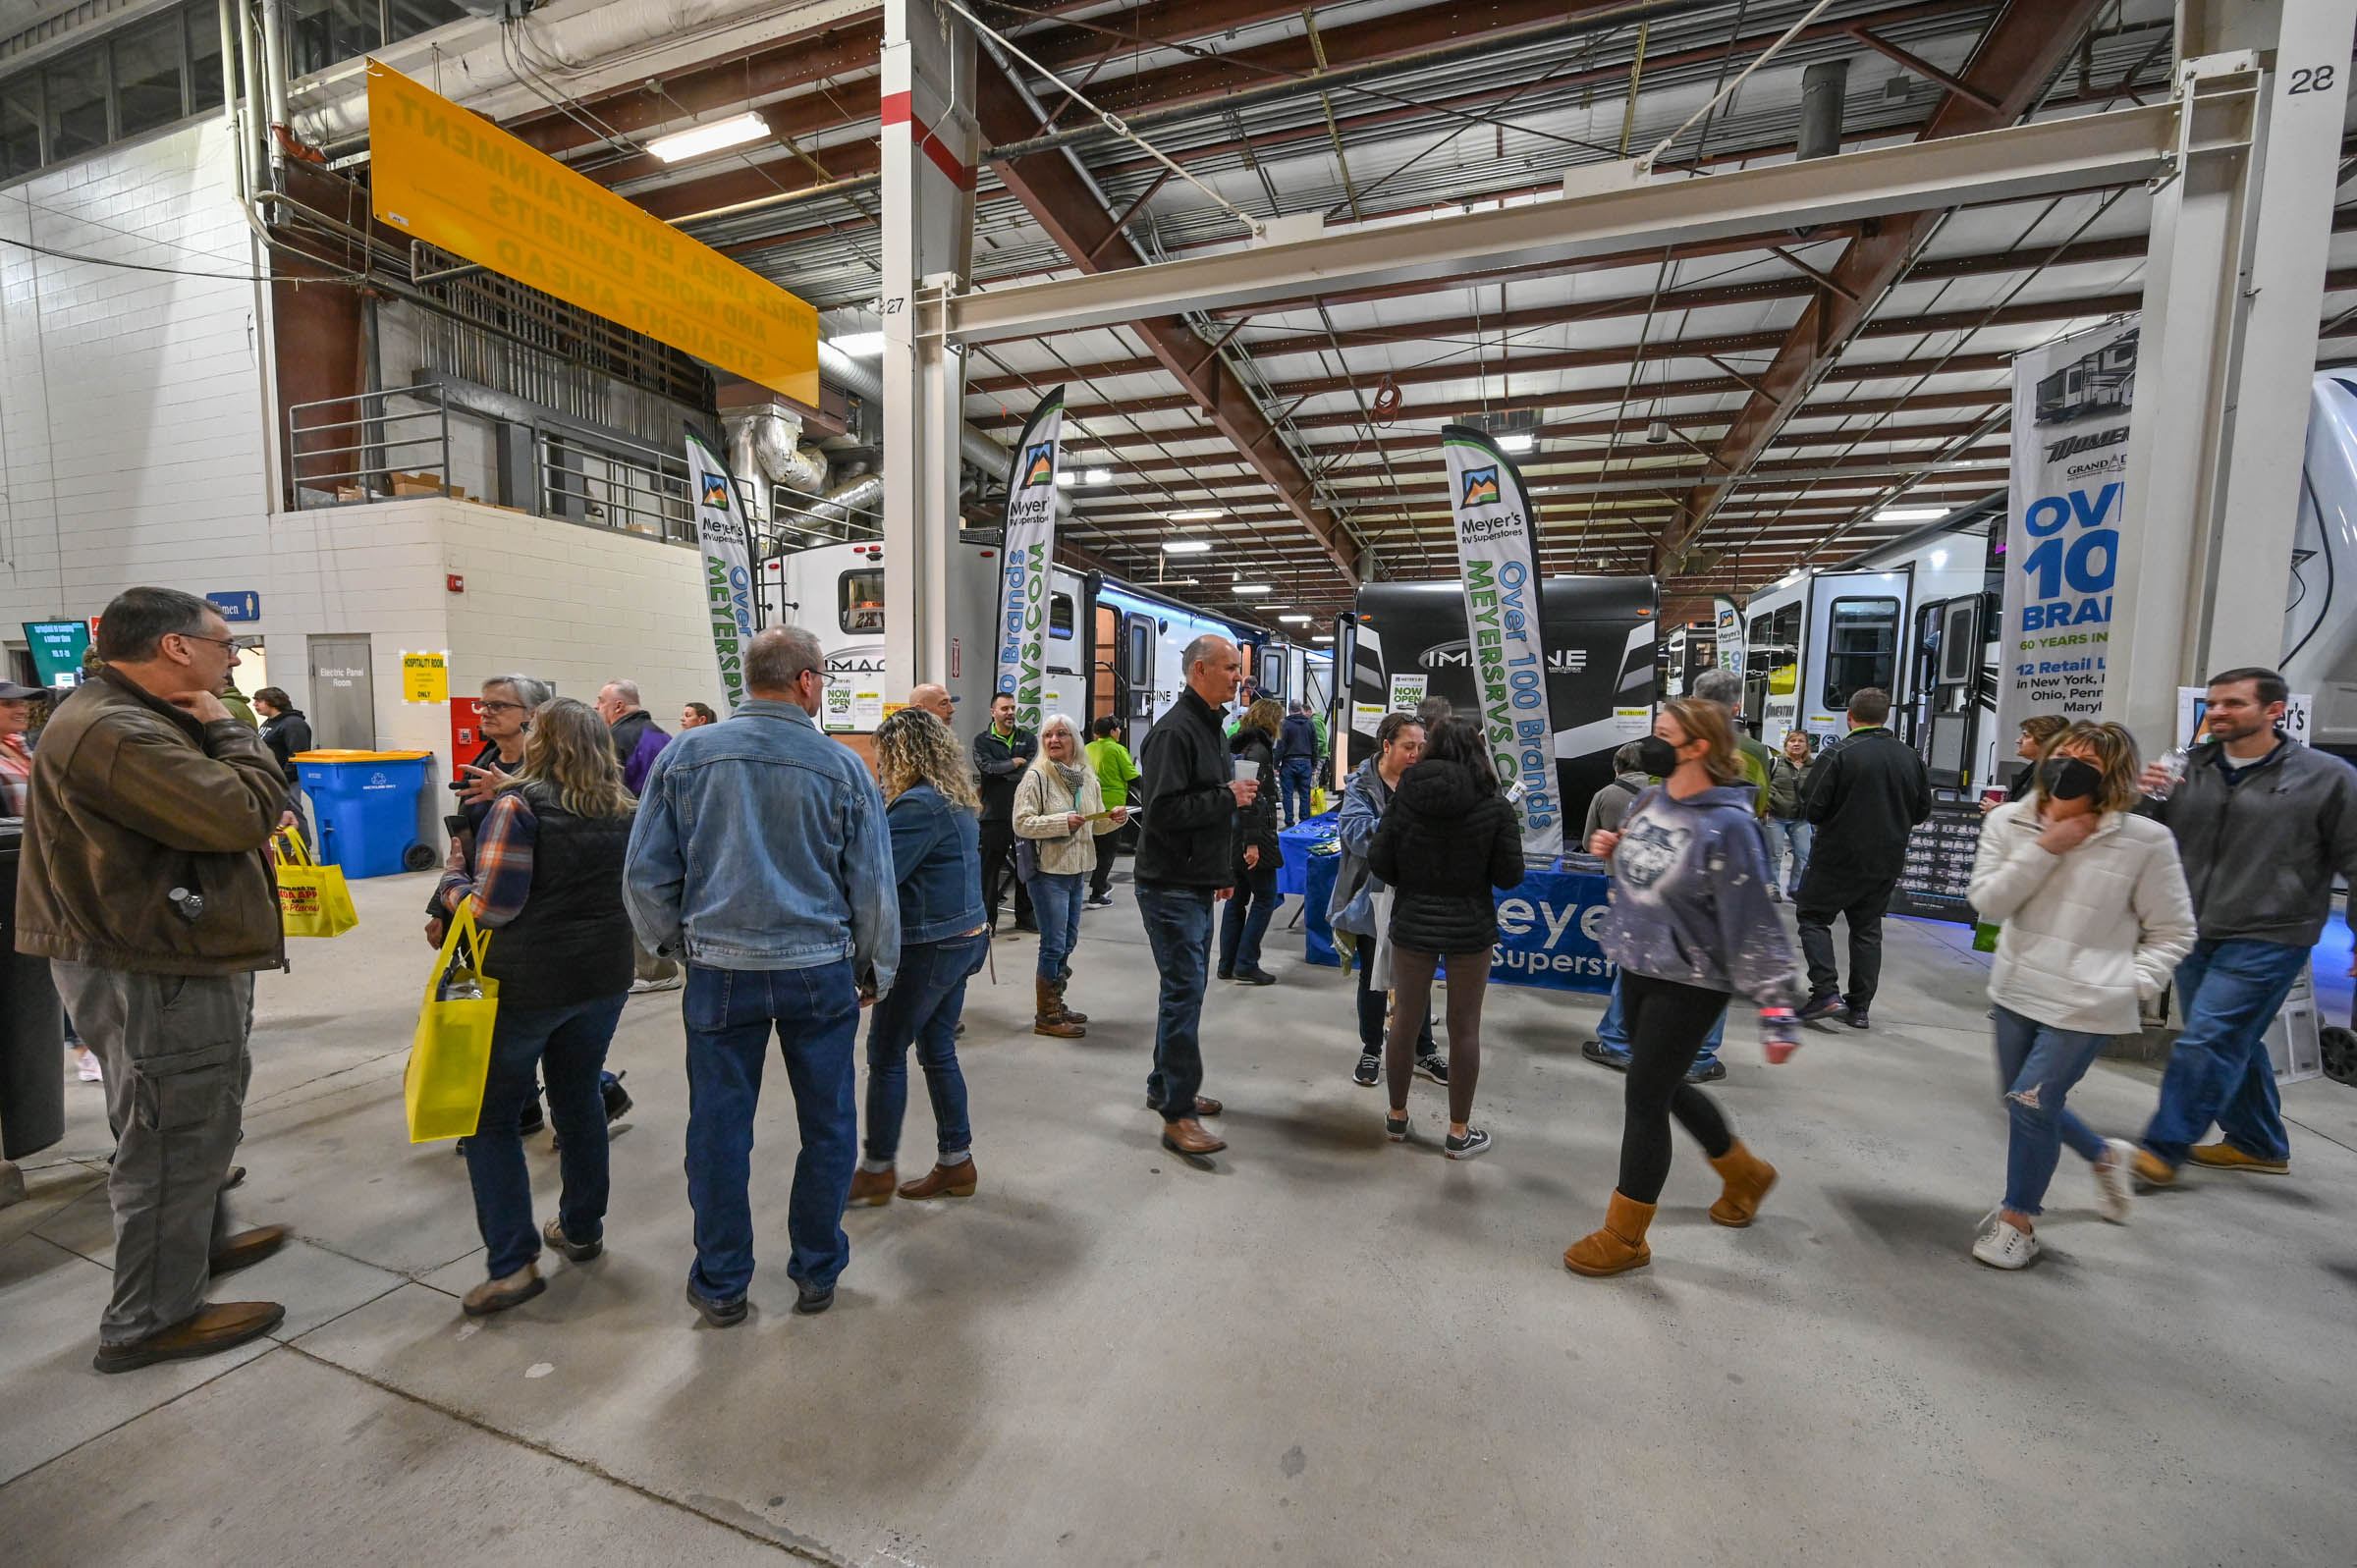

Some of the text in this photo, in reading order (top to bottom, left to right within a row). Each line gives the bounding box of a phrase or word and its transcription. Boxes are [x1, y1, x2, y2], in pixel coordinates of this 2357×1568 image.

[2288, 66, 2334, 95] 28
[886, 297, 904, 315] 27
[2066, 460, 2109, 475] GRAND
[2025, 481, 2125, 538] OV
[1461, 512, 1522, 535] Meyer's
[1473, 528, 1523, 543] Superstores
[730, 565, 753, 638] Over
[1001, 549, 1026, 665] Brands
[2019, 632, 2109, 650] 60 YEARS IN
[405, 658, 430, 668] HOSPITALITY
[2016, 663, 2035, 676] 12
[2039, 658, 2091, 674] Retail
[320, 668, 363, 677] Electric Panel
[2016, 679, 2027, 689] in
[2031, 677, 2060, 688] New
[2063, 674, 2097, 686] York,
[332, 678, 353, 687] Room
[827, 689, 850, 698] NOW
[1498, 561, 1559, 830] Over 100 Brands
[2031, 689, 2065, 701] Ohio,
